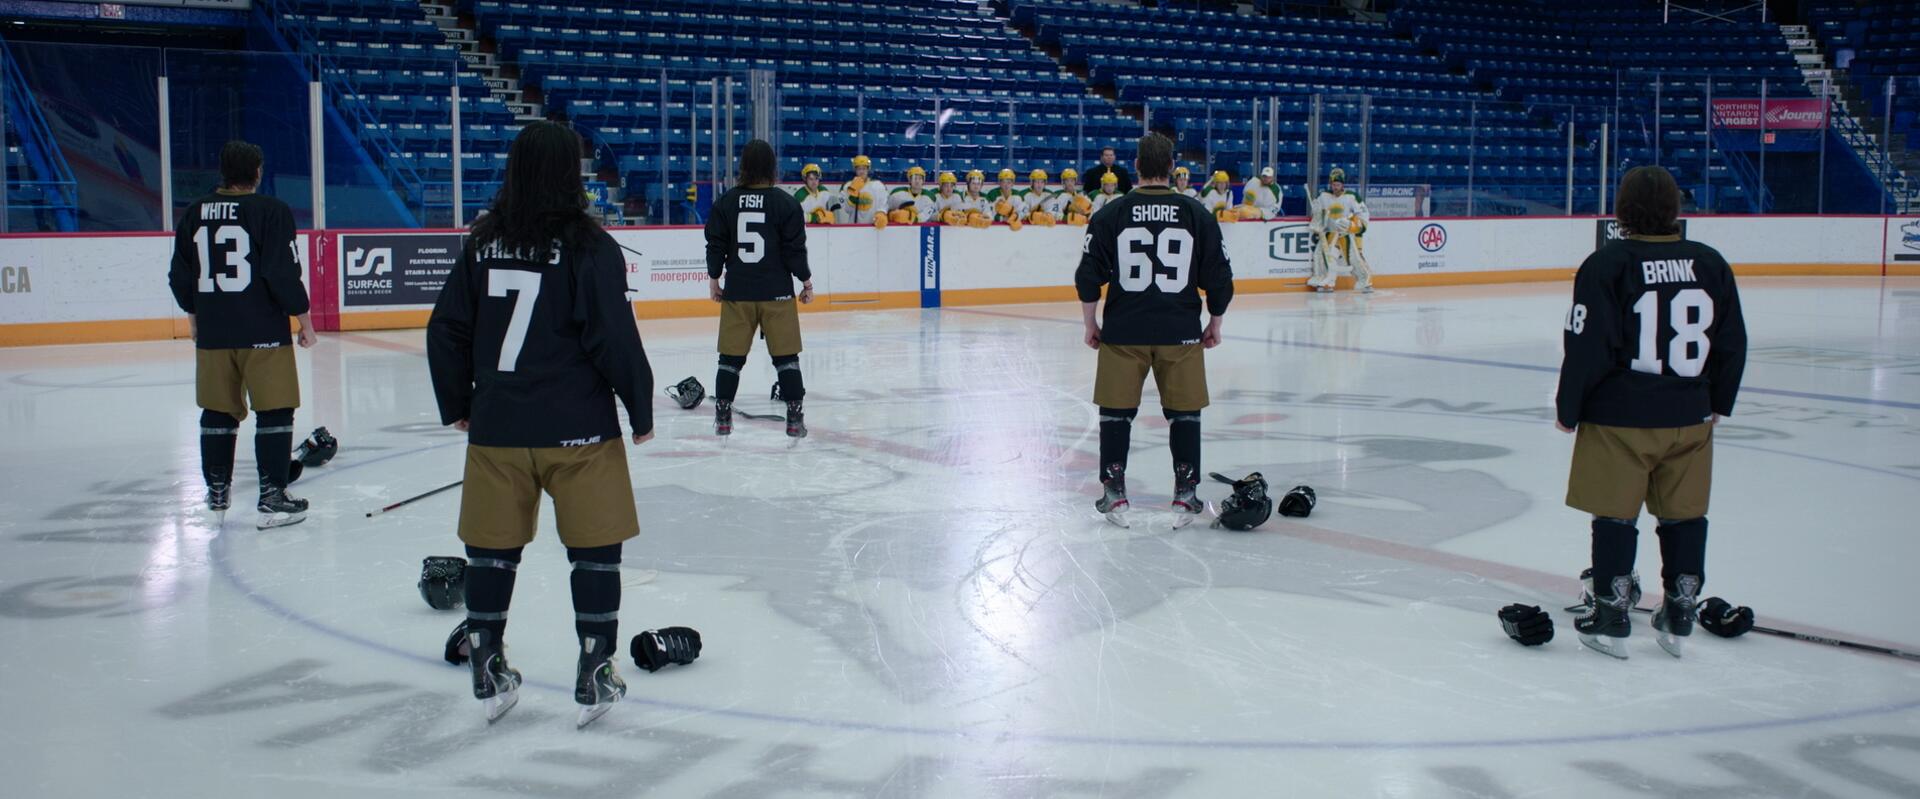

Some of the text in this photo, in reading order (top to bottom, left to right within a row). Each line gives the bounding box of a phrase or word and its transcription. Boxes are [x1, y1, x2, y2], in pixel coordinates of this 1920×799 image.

[1778, 110, 1823, 120] Journa
[738, 194, 765, 209] FISH
[1382, 187, 1415, 196] BRACING
[201, 201, 239, 220] WHITE
[1132, 204, 1180, 223] SHORE
[737, 211, 766, 264] 5
[1421, 227, 1444, 248] CAA
[193, 225, 252, 293] 13
[1116, 226, 1195, 294] 69
[1641, 258, 1697, 285] BRINK
[347, 279, 393, 289] SURFACE
[488, 268, 543, 373] 7
[1564, 303, 1588, 336] 18
[1630, 288, 1715, 378] 18
[252, 341, 280, 349] TRUE
[560, 435, 601, 447] TRUE
